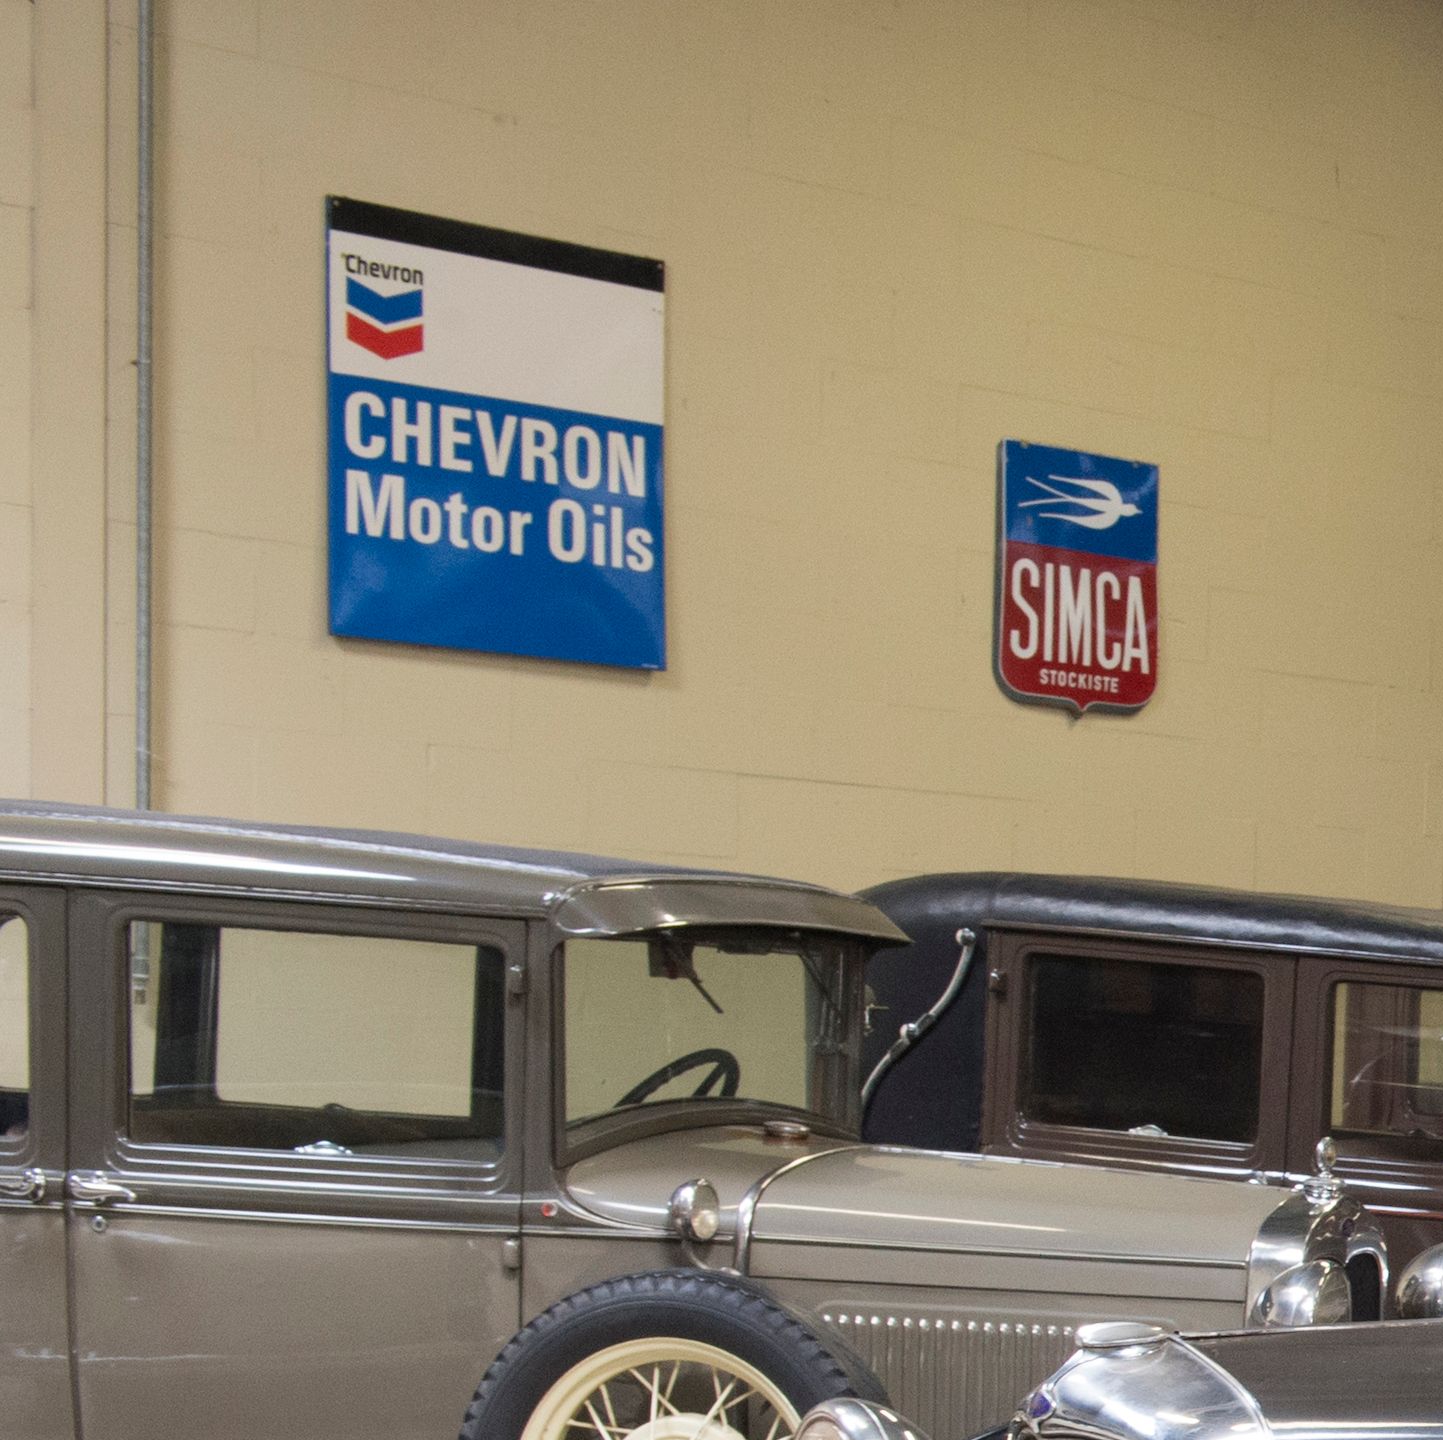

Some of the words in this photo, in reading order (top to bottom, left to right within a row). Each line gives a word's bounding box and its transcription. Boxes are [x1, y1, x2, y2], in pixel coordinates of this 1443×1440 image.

[344, 253, 424, 286] Chevron
[344, 391, 646, 498] CHEVRON
[345, 468, 533, 556] Motor
[547, 498, 655, 572] Oils
[1010, 558, 1150, 675] SIMCA
[1039, 668, 1120, 693] STOCKISTE
